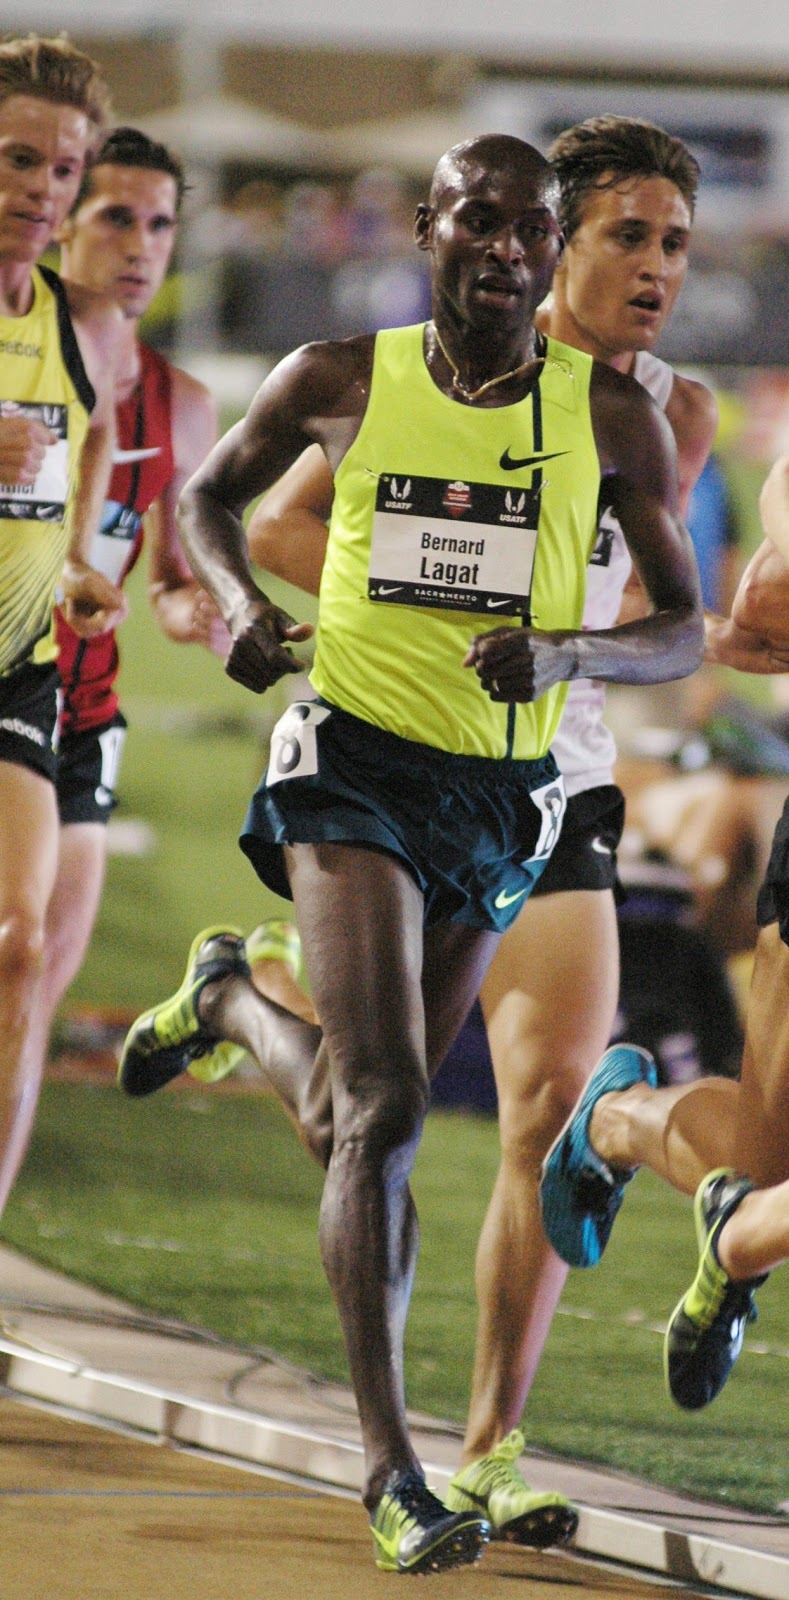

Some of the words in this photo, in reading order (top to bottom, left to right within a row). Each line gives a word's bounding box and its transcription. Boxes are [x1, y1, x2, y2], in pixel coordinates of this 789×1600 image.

[385, 501, 412, 510] USATF
[500, 514, 526, 523] USATF
[421, 532, 485, 556] Bernard
[420, 557, 479, 585] Lagat
[0, 718, 46, 747] ebok
